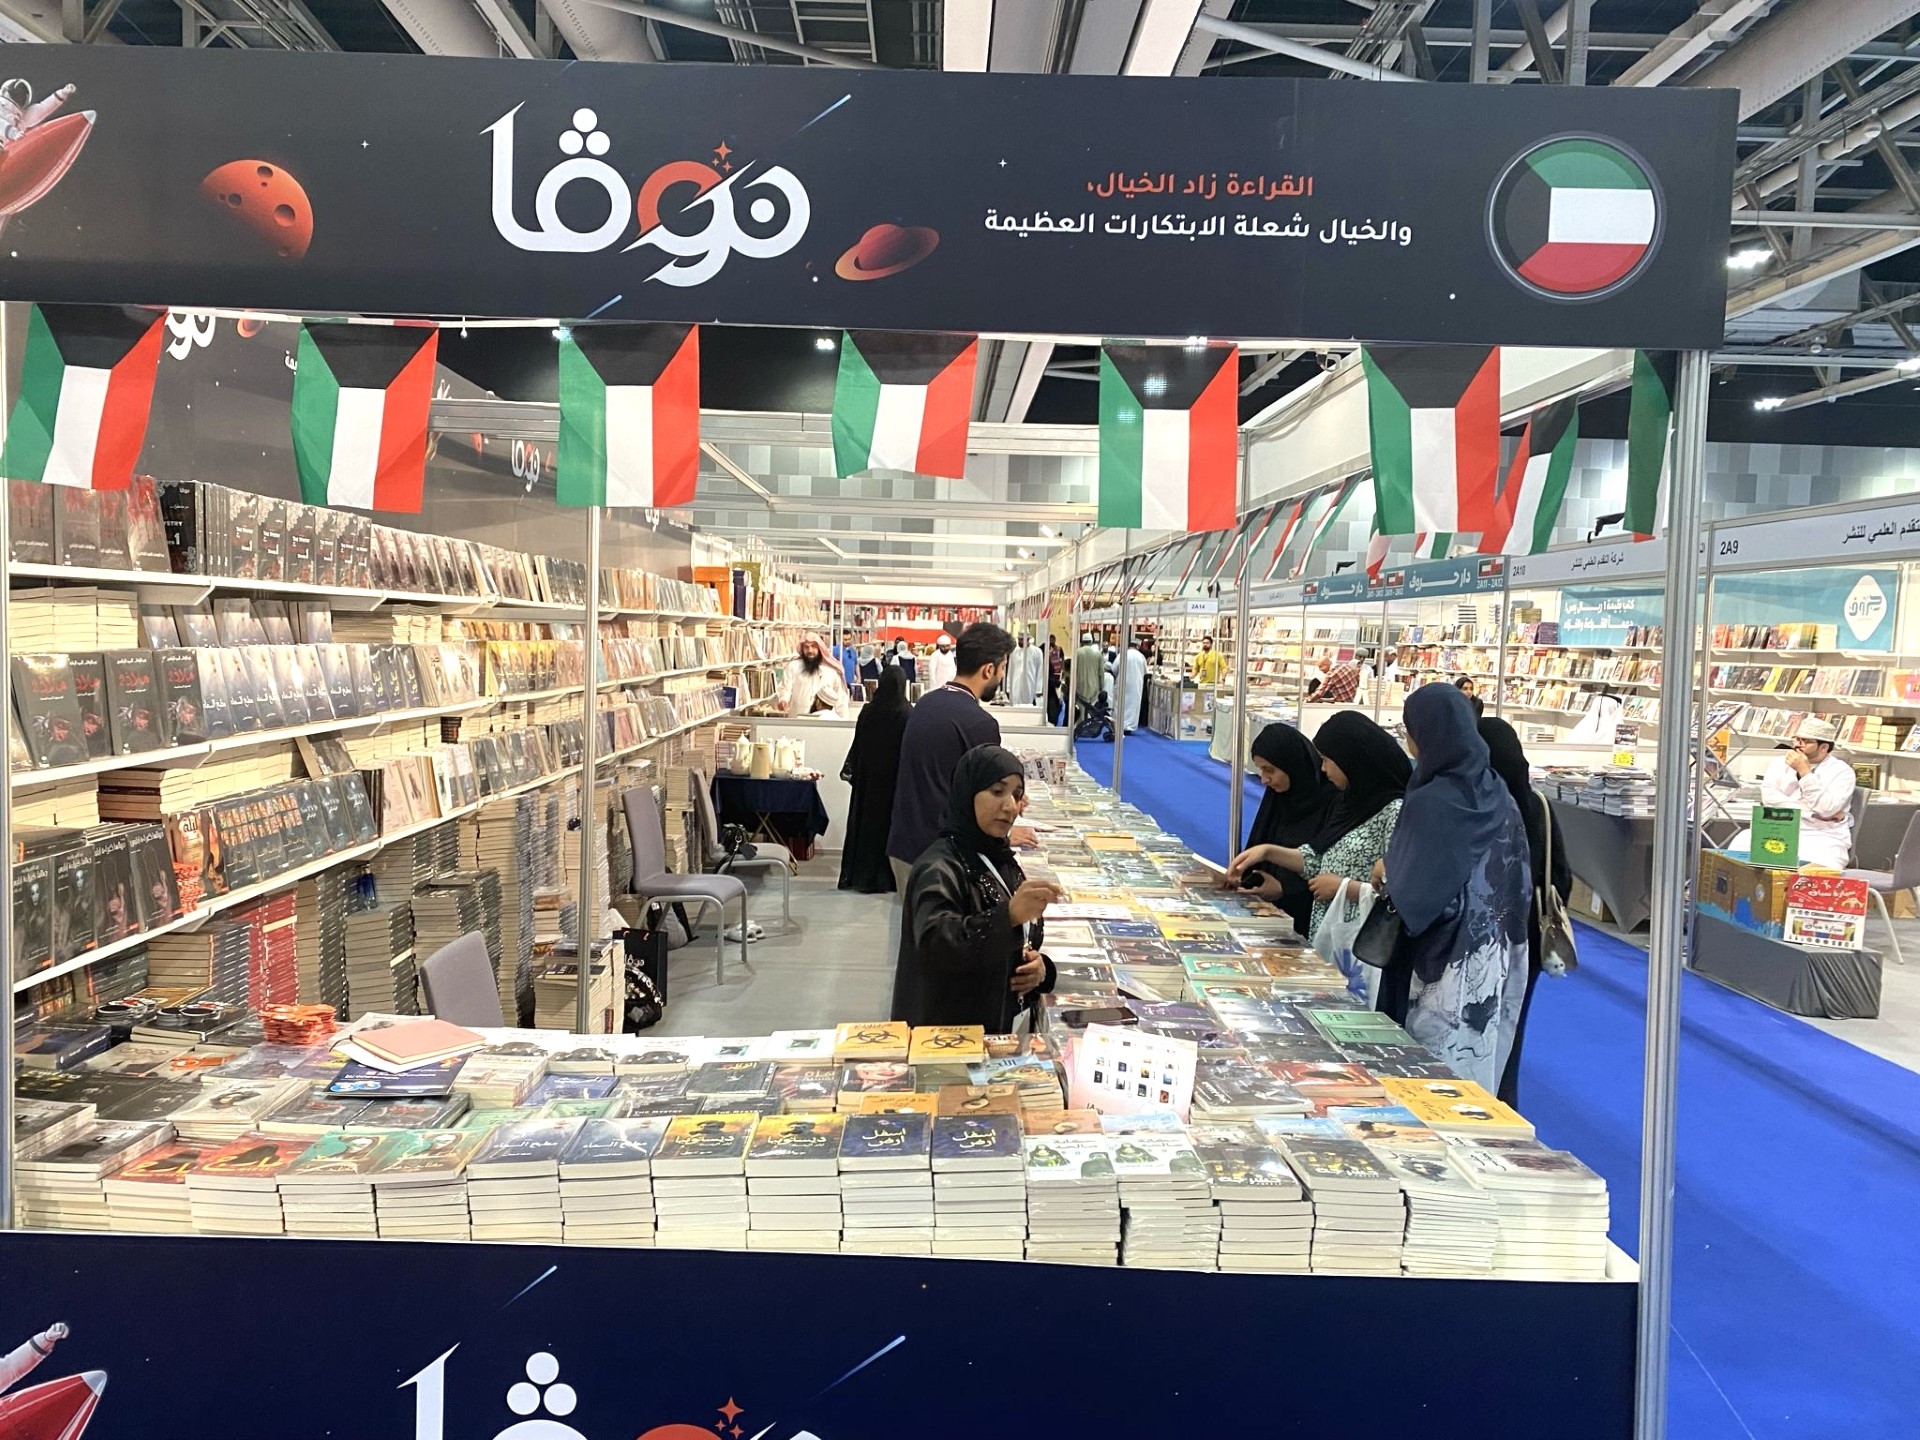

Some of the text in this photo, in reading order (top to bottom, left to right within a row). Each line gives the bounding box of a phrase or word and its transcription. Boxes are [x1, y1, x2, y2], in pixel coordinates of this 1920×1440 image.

[1086, 171, 1314, 200] القراءة زاد الخيال،
[983, 208, 1413, 246] والخيال شعلة الابتكارات العظيمة
[1842, 524, 1866, 544] للنشر
[1868, 521, 1897, 544] العلمي
[1720, 539, 1739, 555] 2A9
[1597, 554, 1610, 566] التقدم
[1610, 551, 1624, 566] شركة
[1460, 568, 1471, 589] دار
[1513, 565, 1526, 577] 2A10
